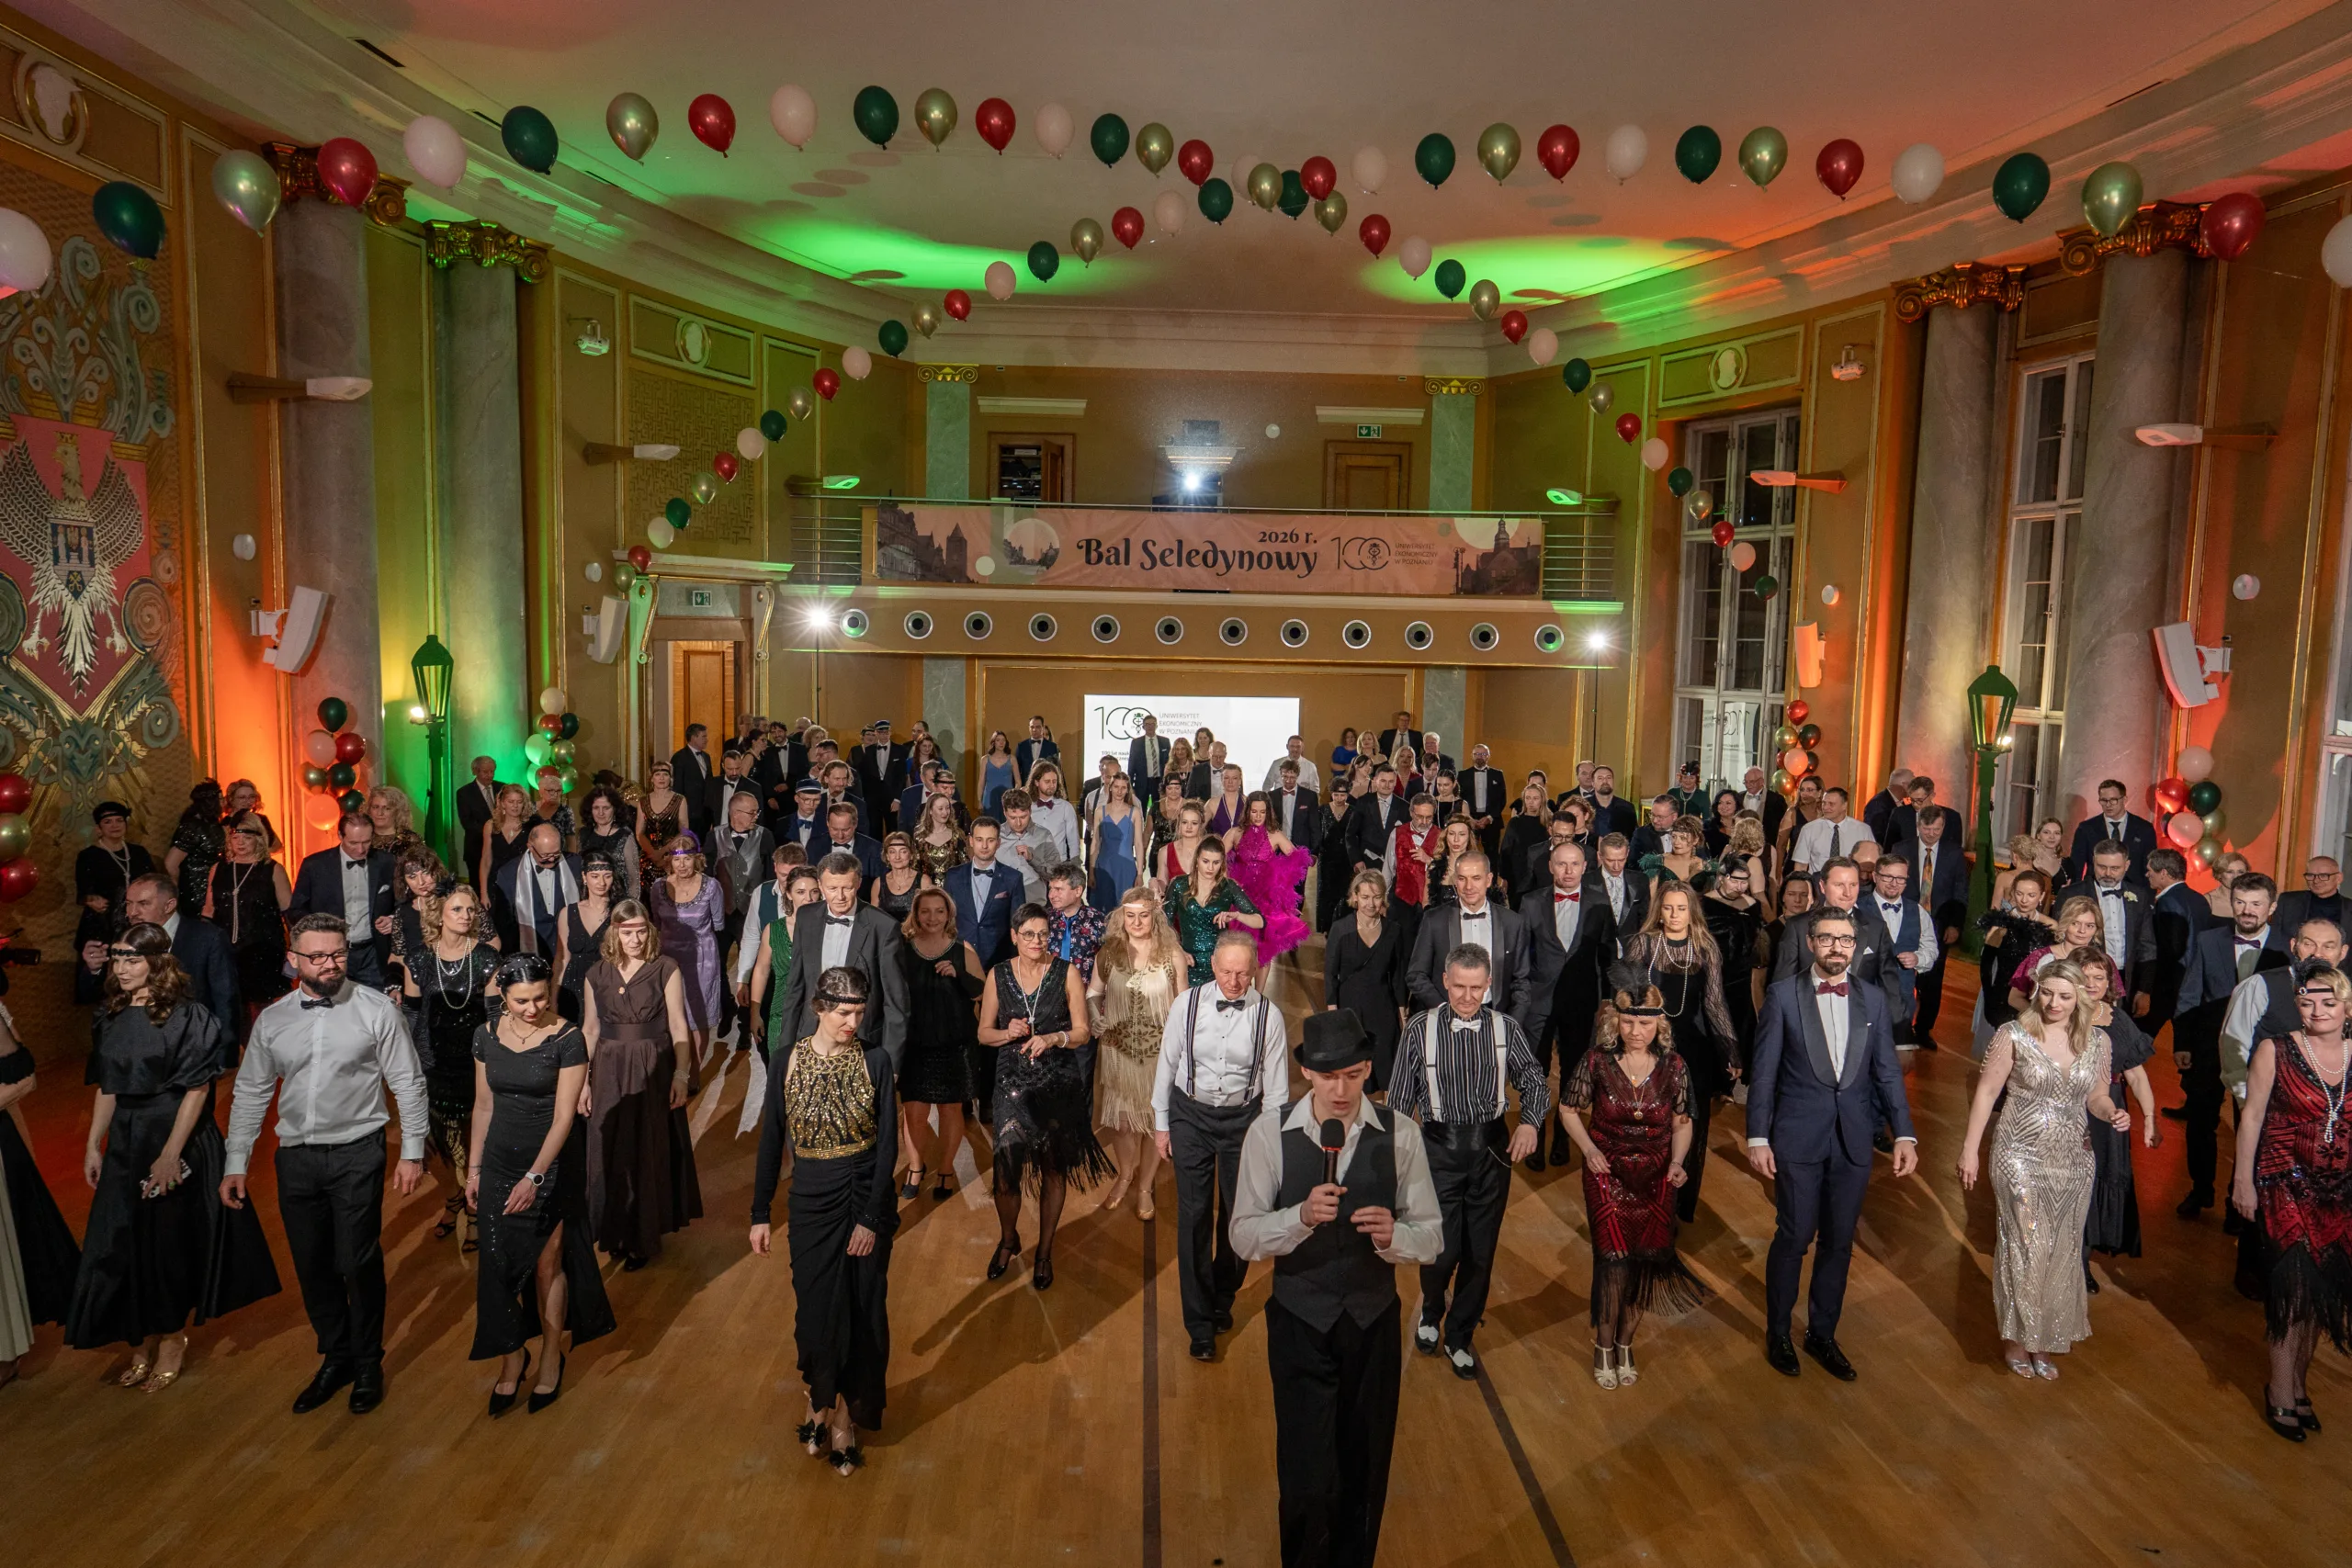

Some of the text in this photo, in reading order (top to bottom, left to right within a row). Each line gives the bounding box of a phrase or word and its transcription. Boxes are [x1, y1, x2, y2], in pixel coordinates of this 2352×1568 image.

[1258, 527, 1317, 544] 2026 r.
[1076, 538, 1317, 579] Bal Seledynowy
[1330, 536, 1391, 570] 100
[1159, 711, 1200, 719] UNIWERSYTET
